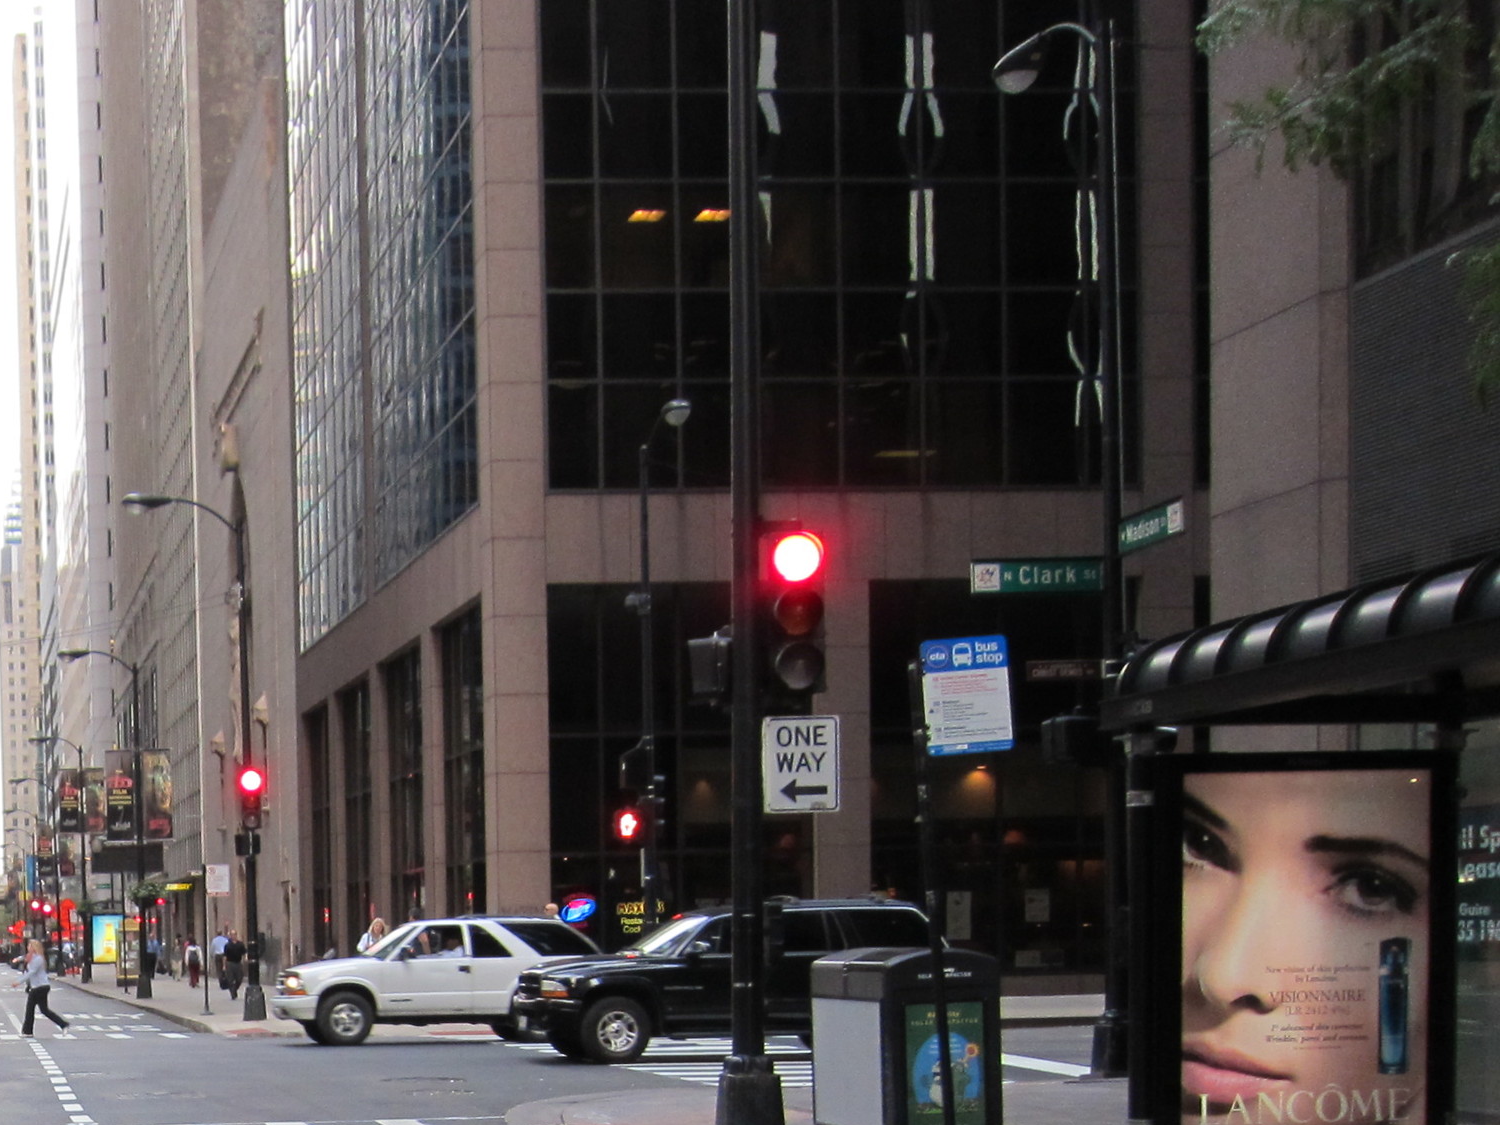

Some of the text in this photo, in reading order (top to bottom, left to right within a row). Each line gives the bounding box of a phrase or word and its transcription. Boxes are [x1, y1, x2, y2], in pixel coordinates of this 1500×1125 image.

[1003, 571, 1012, 581] N
[1018, 565, 1077, 585] Clark
[975, 641, 998, 653] bus
[929, 652, 945, 661] cta
[975, 652, 1004, 665] stop
[776, 725, 828, 747] ONE
[776, 752, 827, 773] WAY
[1269, 989, 1366, 1003] VISIONNAIRE
[1199, 1083, 1412, 1125] LANCÔME
